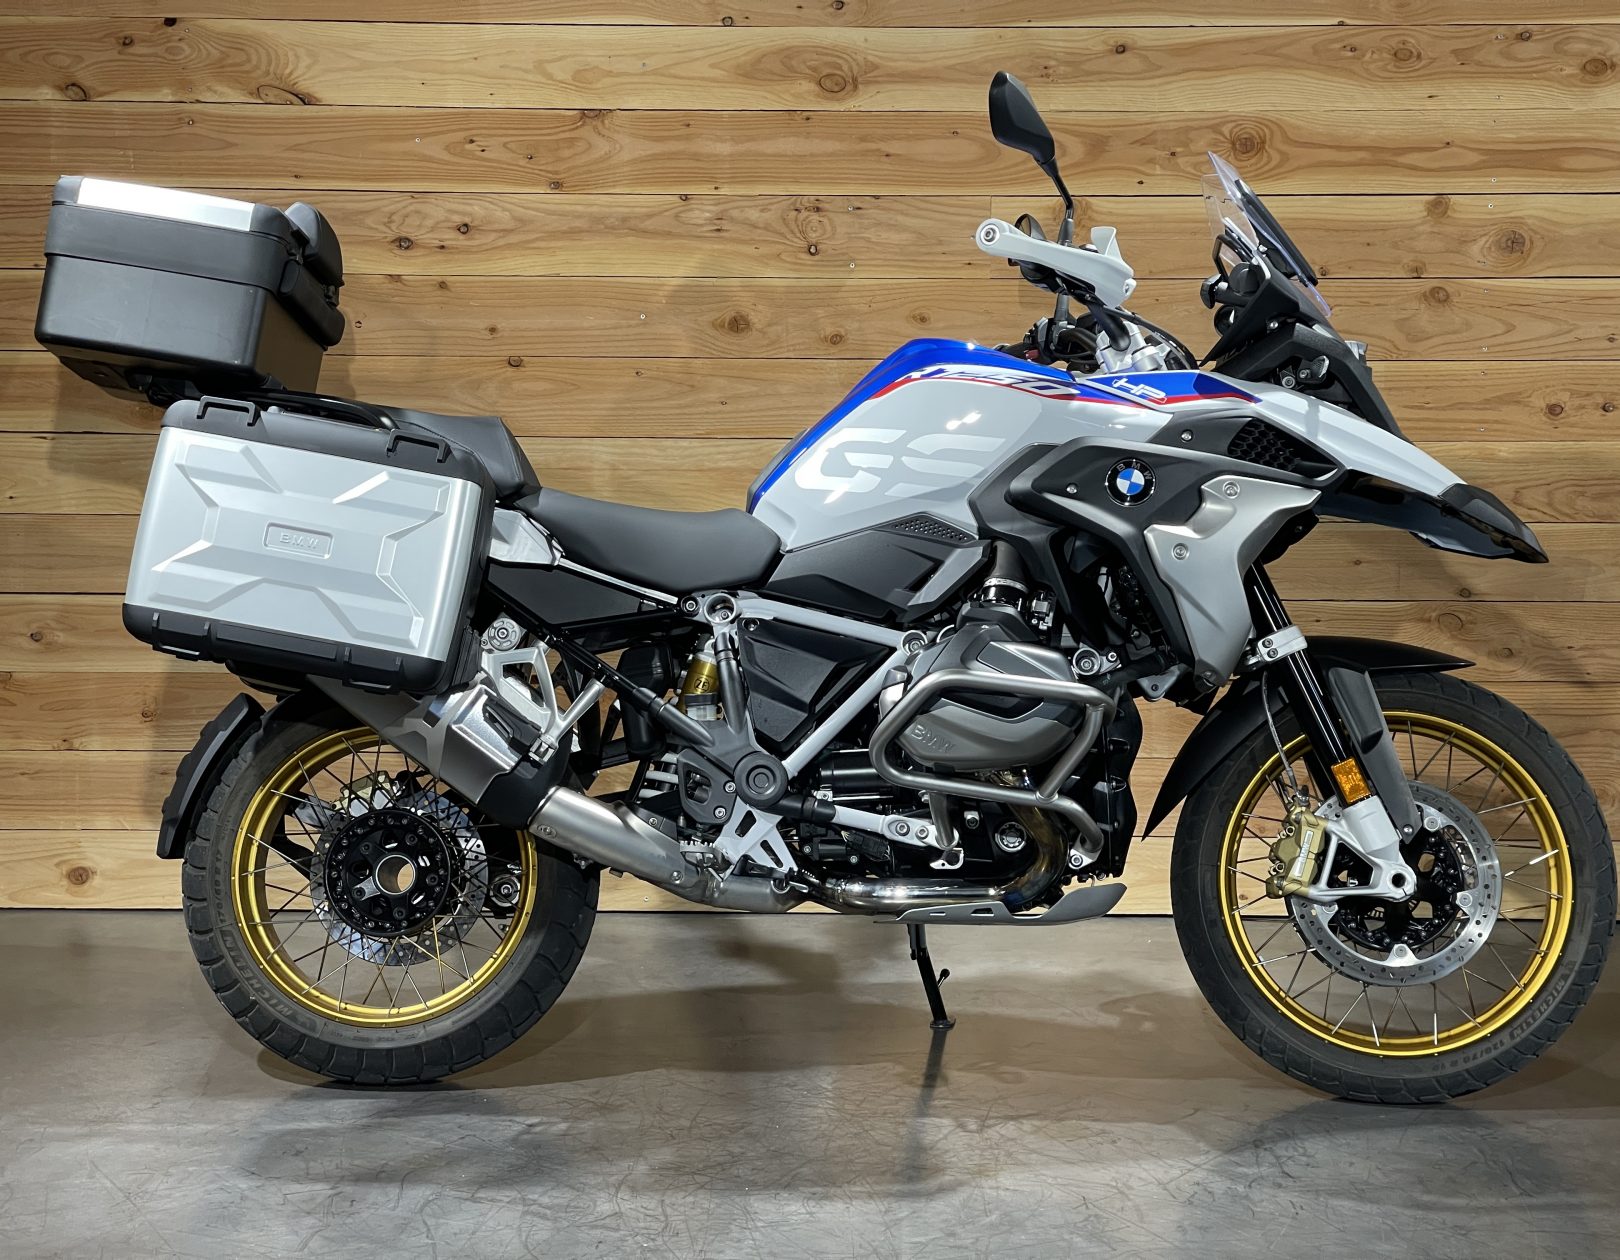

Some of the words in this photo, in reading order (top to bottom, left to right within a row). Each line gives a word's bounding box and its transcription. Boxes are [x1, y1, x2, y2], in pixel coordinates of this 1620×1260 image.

[1112, 377, 1167, 403] HP
[795, 427, 1006, 502] GS
[1115, 461, 1153, 480] BMW
[280, 532, 320, 549] BMW
[694, 679, 709, 690] ZF
[910, 723, 955, 753] BMW
[222, 933, 294, 1018] MICHELIN
[1512, 979, 1566, 1038] MICHELIN
